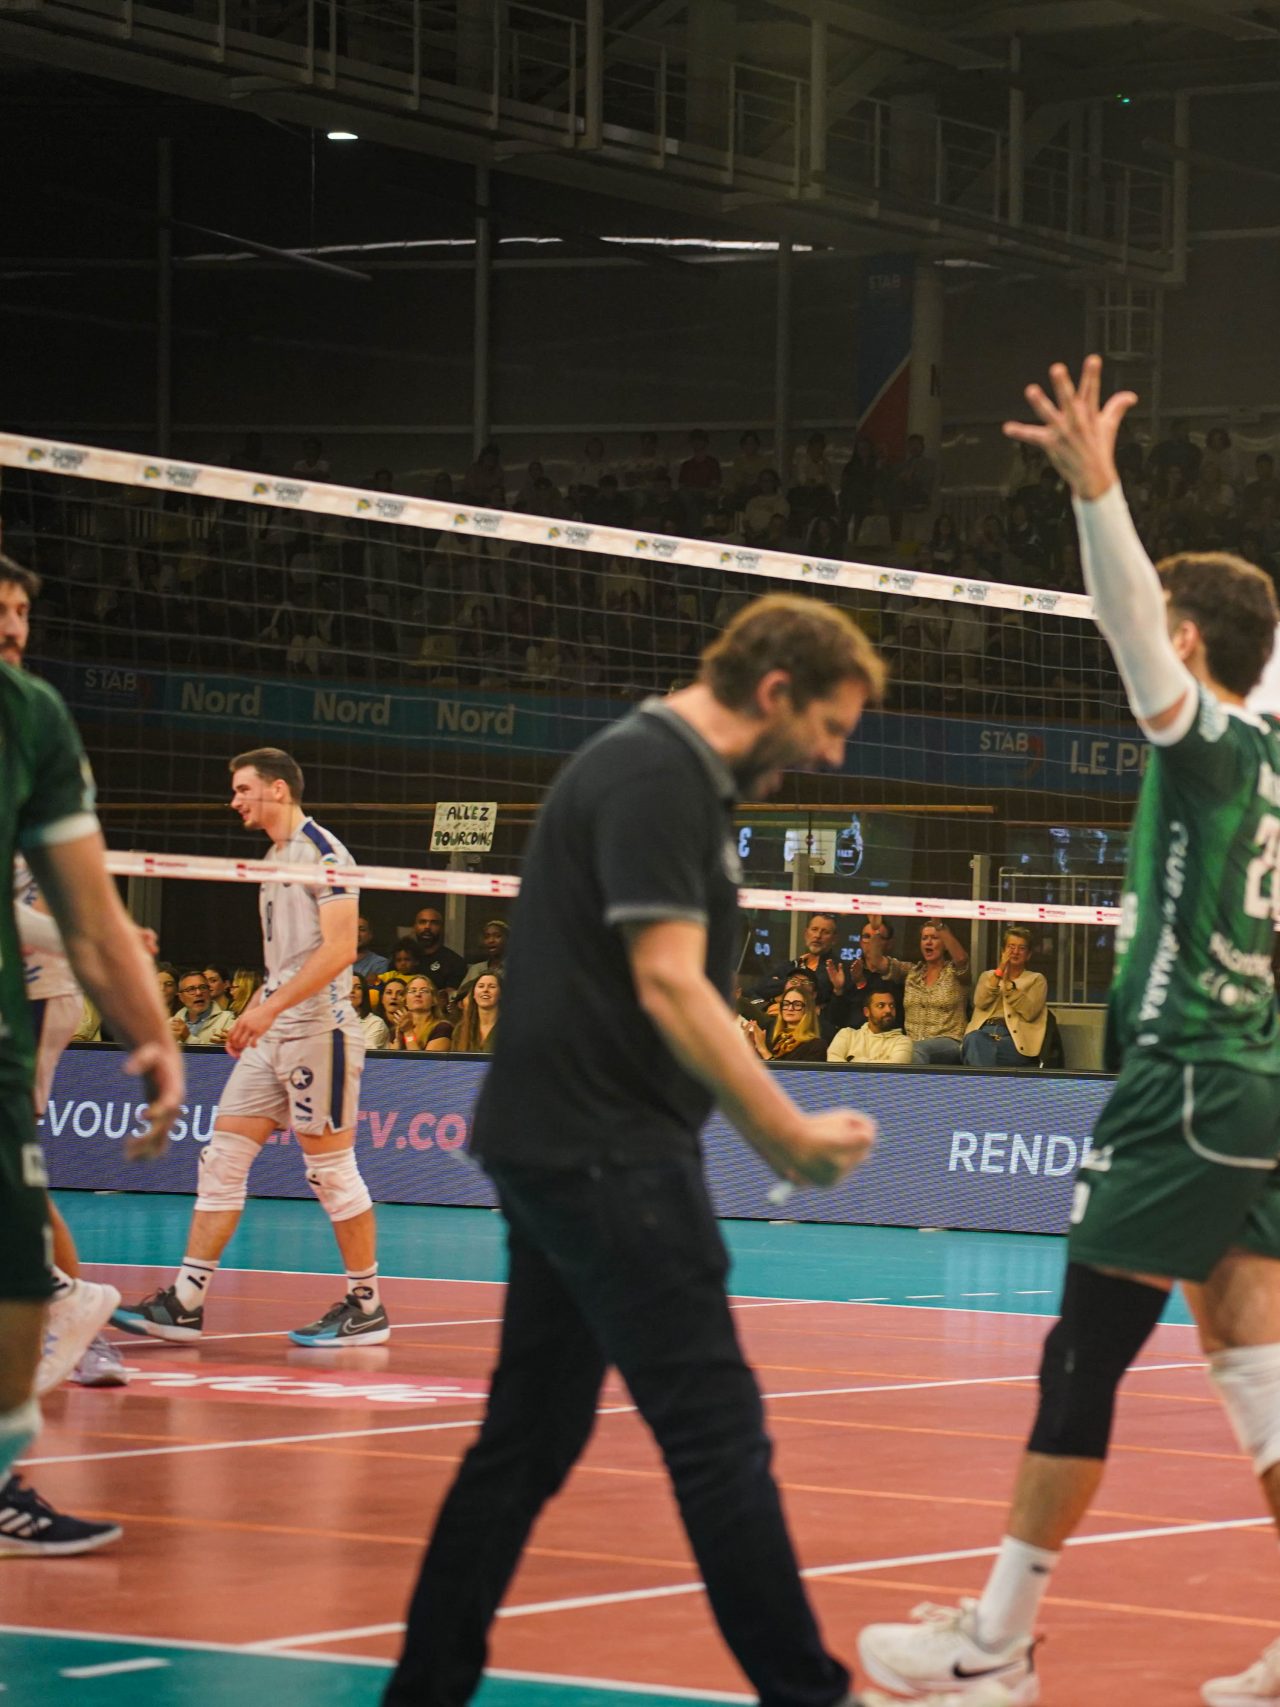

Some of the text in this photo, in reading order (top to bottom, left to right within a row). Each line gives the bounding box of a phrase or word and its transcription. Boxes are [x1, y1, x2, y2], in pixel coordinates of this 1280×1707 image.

[84, 668, 137, 692] STAB
[182, 681, 262, 717] Nord
[313, 691, 391, 726] Nord
[436, 702, 515, 736] Nord
[979, 730, 1029, 753] STAB
[1069, 740, 1108, 776] LE
[446, 806, 490, 821] ALLEZ
